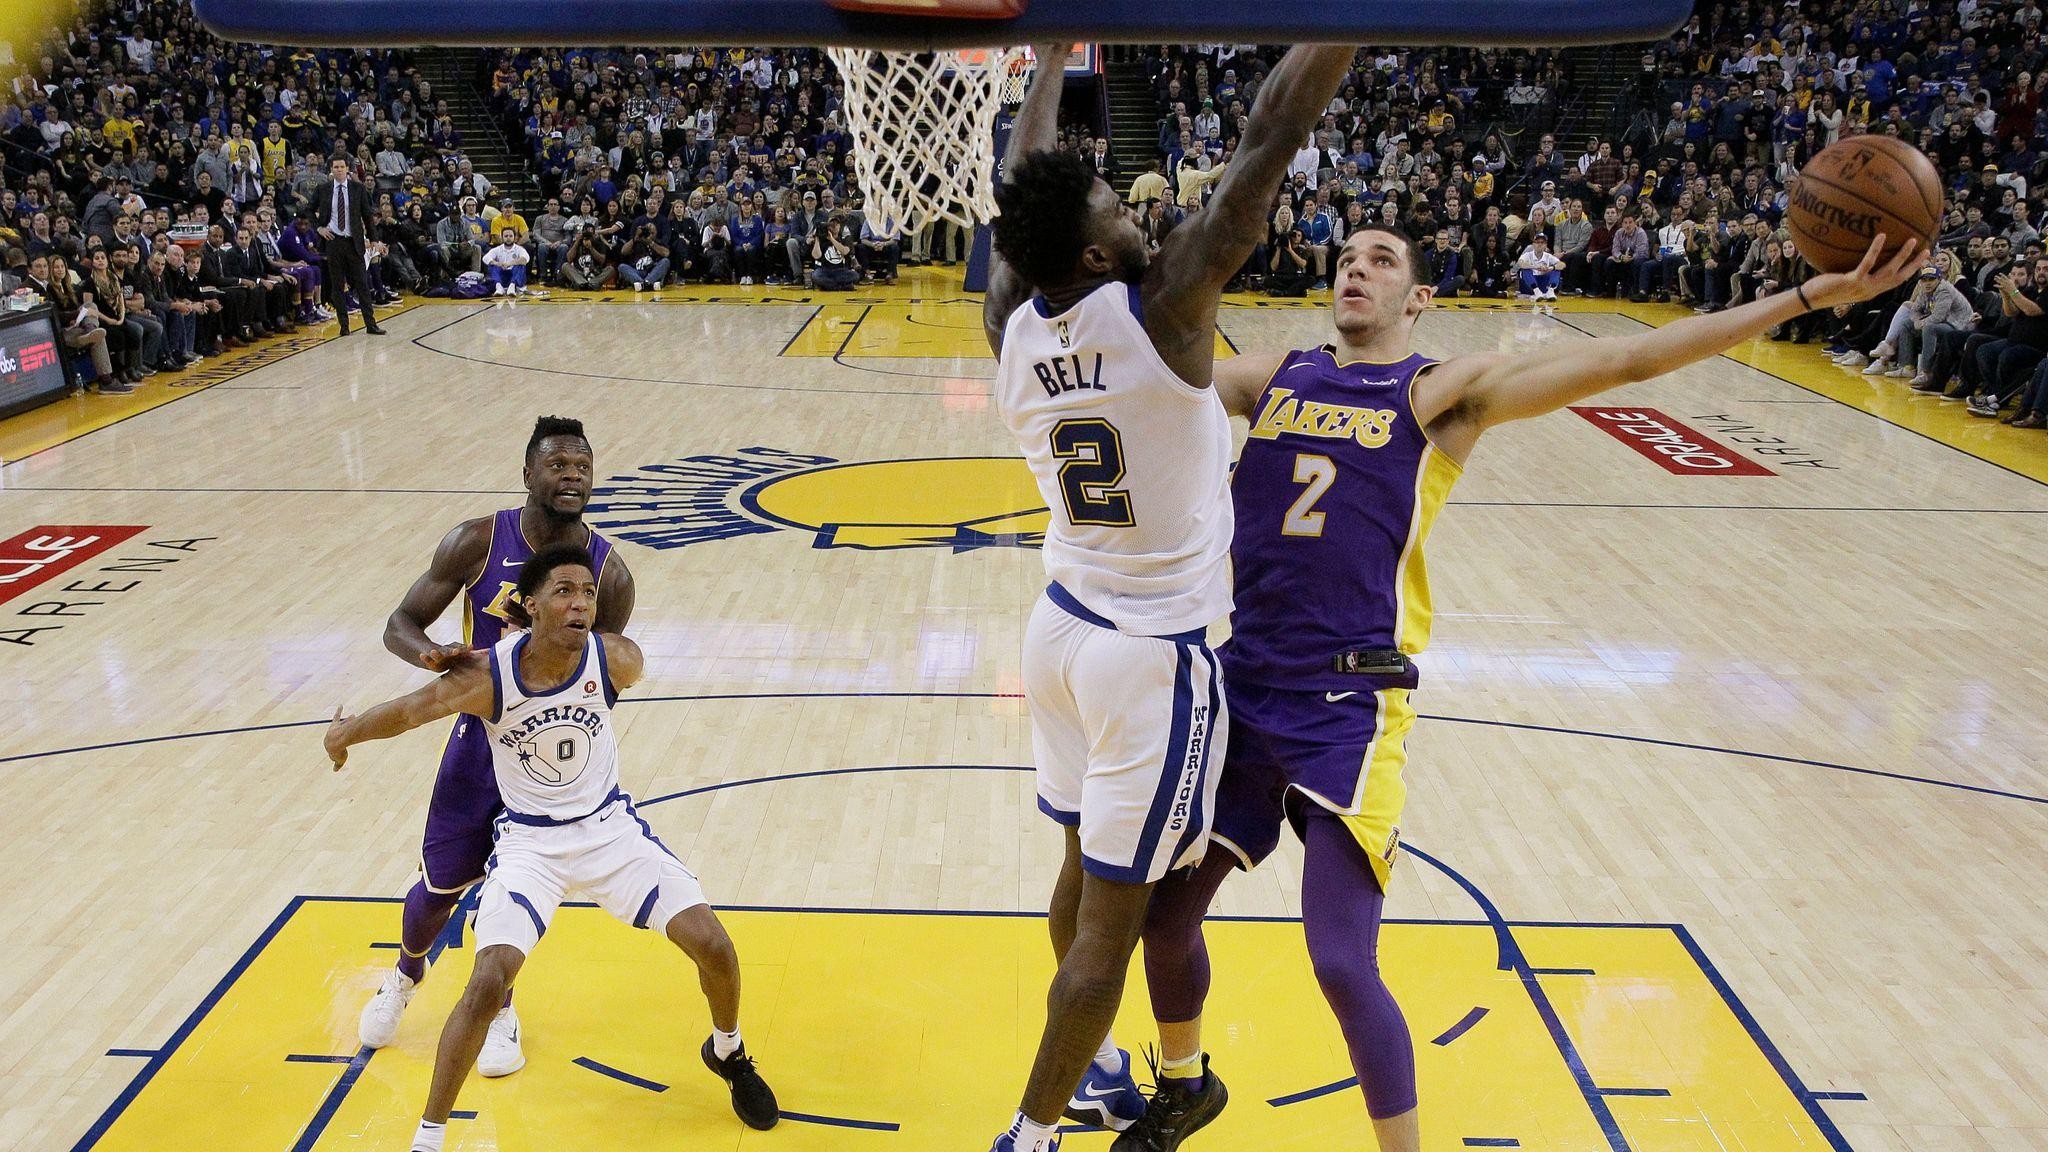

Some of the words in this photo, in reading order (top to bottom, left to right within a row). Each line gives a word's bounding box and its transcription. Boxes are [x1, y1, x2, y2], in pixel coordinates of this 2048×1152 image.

[1792, 178, 1882, 239] SPALDING
[0, 355, 17, 374] abc
[19, 341, 56, 372] ESPN
[1033, 352, 1107, 398] BELL
[1249, 387, 1398, 449] LAKERS
[1595, 411, 1734, 469] ORACLE
[1691, 414, 1840, 470] ARENA
[583, 446, 840, 550] WARRIORS
[1049, 416, 1137, 527] 2
[1281, 453, 1338, 538] 2
[0, 536, 218, 646] ARENA
[499, 704, 605, 748] WARRIORS
[557, 738, 576, 763] 0
[1170, 705, 1208, 831] WARRIORS
